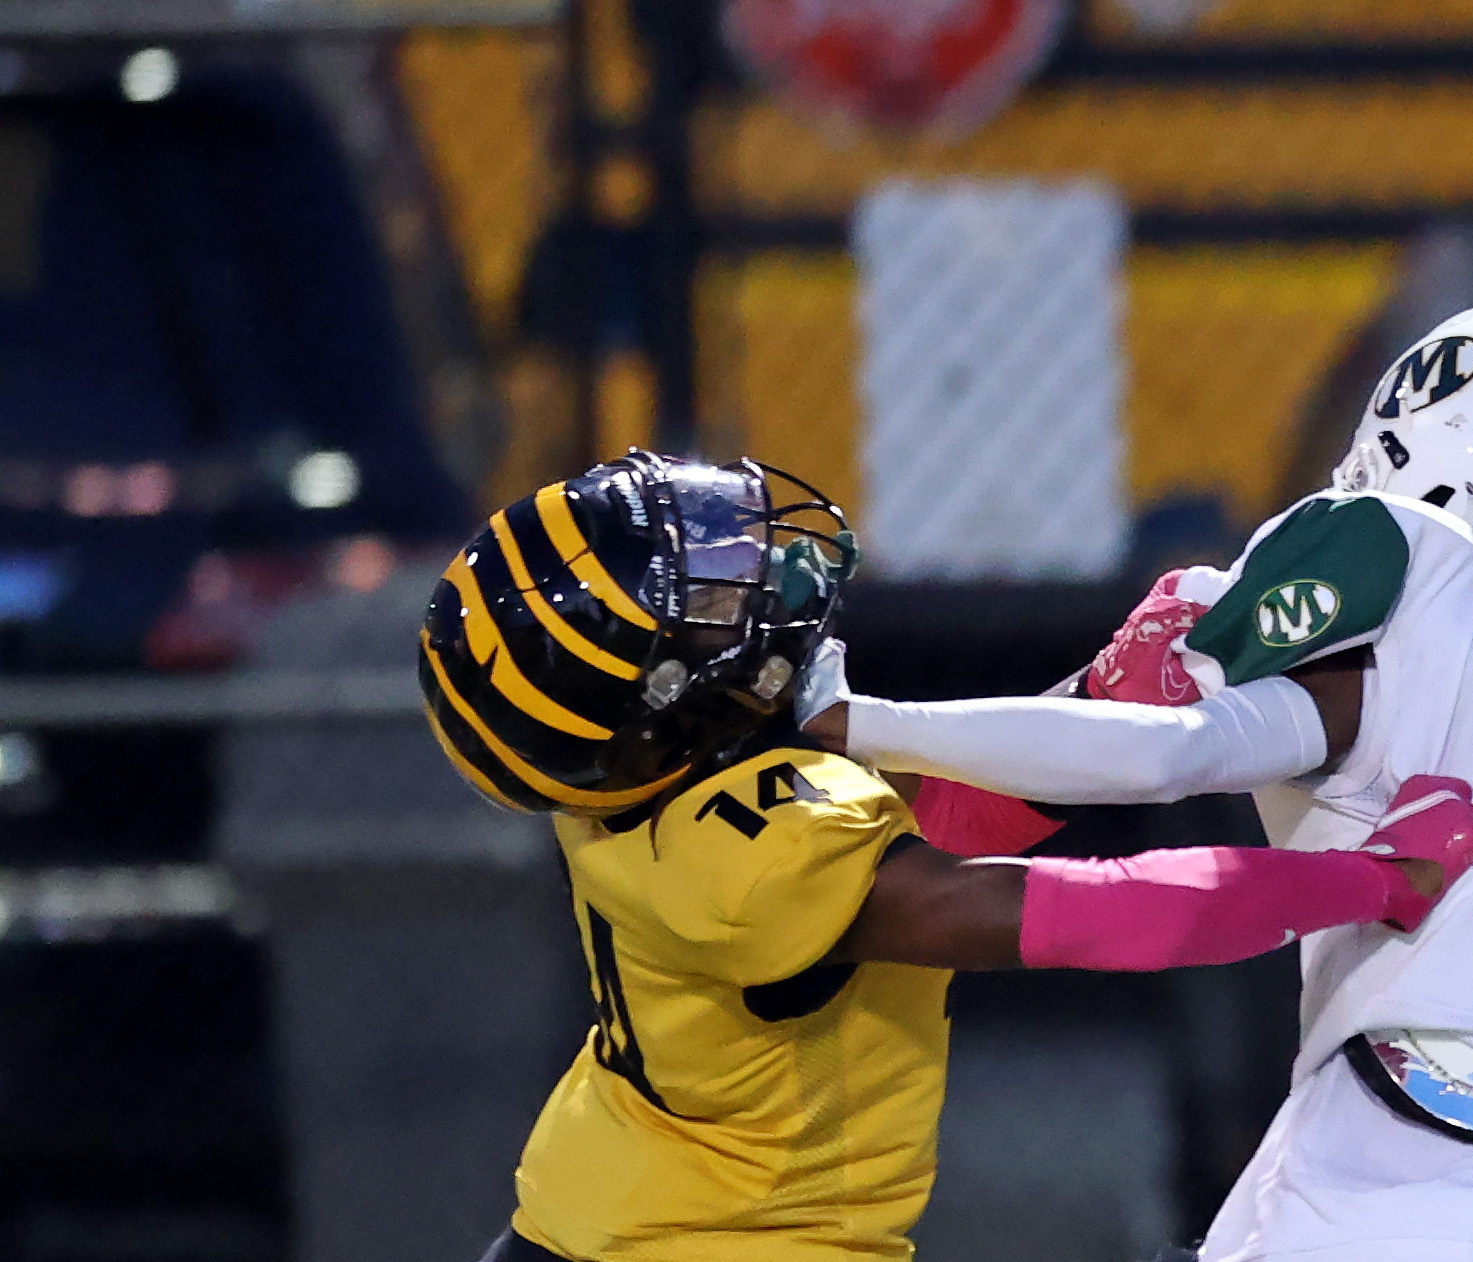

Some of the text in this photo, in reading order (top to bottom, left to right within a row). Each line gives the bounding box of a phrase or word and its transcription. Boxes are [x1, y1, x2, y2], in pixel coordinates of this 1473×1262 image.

[1374, 336, 1467, 418] M
[1261, 581, 1337, 647] M
[695, 762, 833, 840] 14
